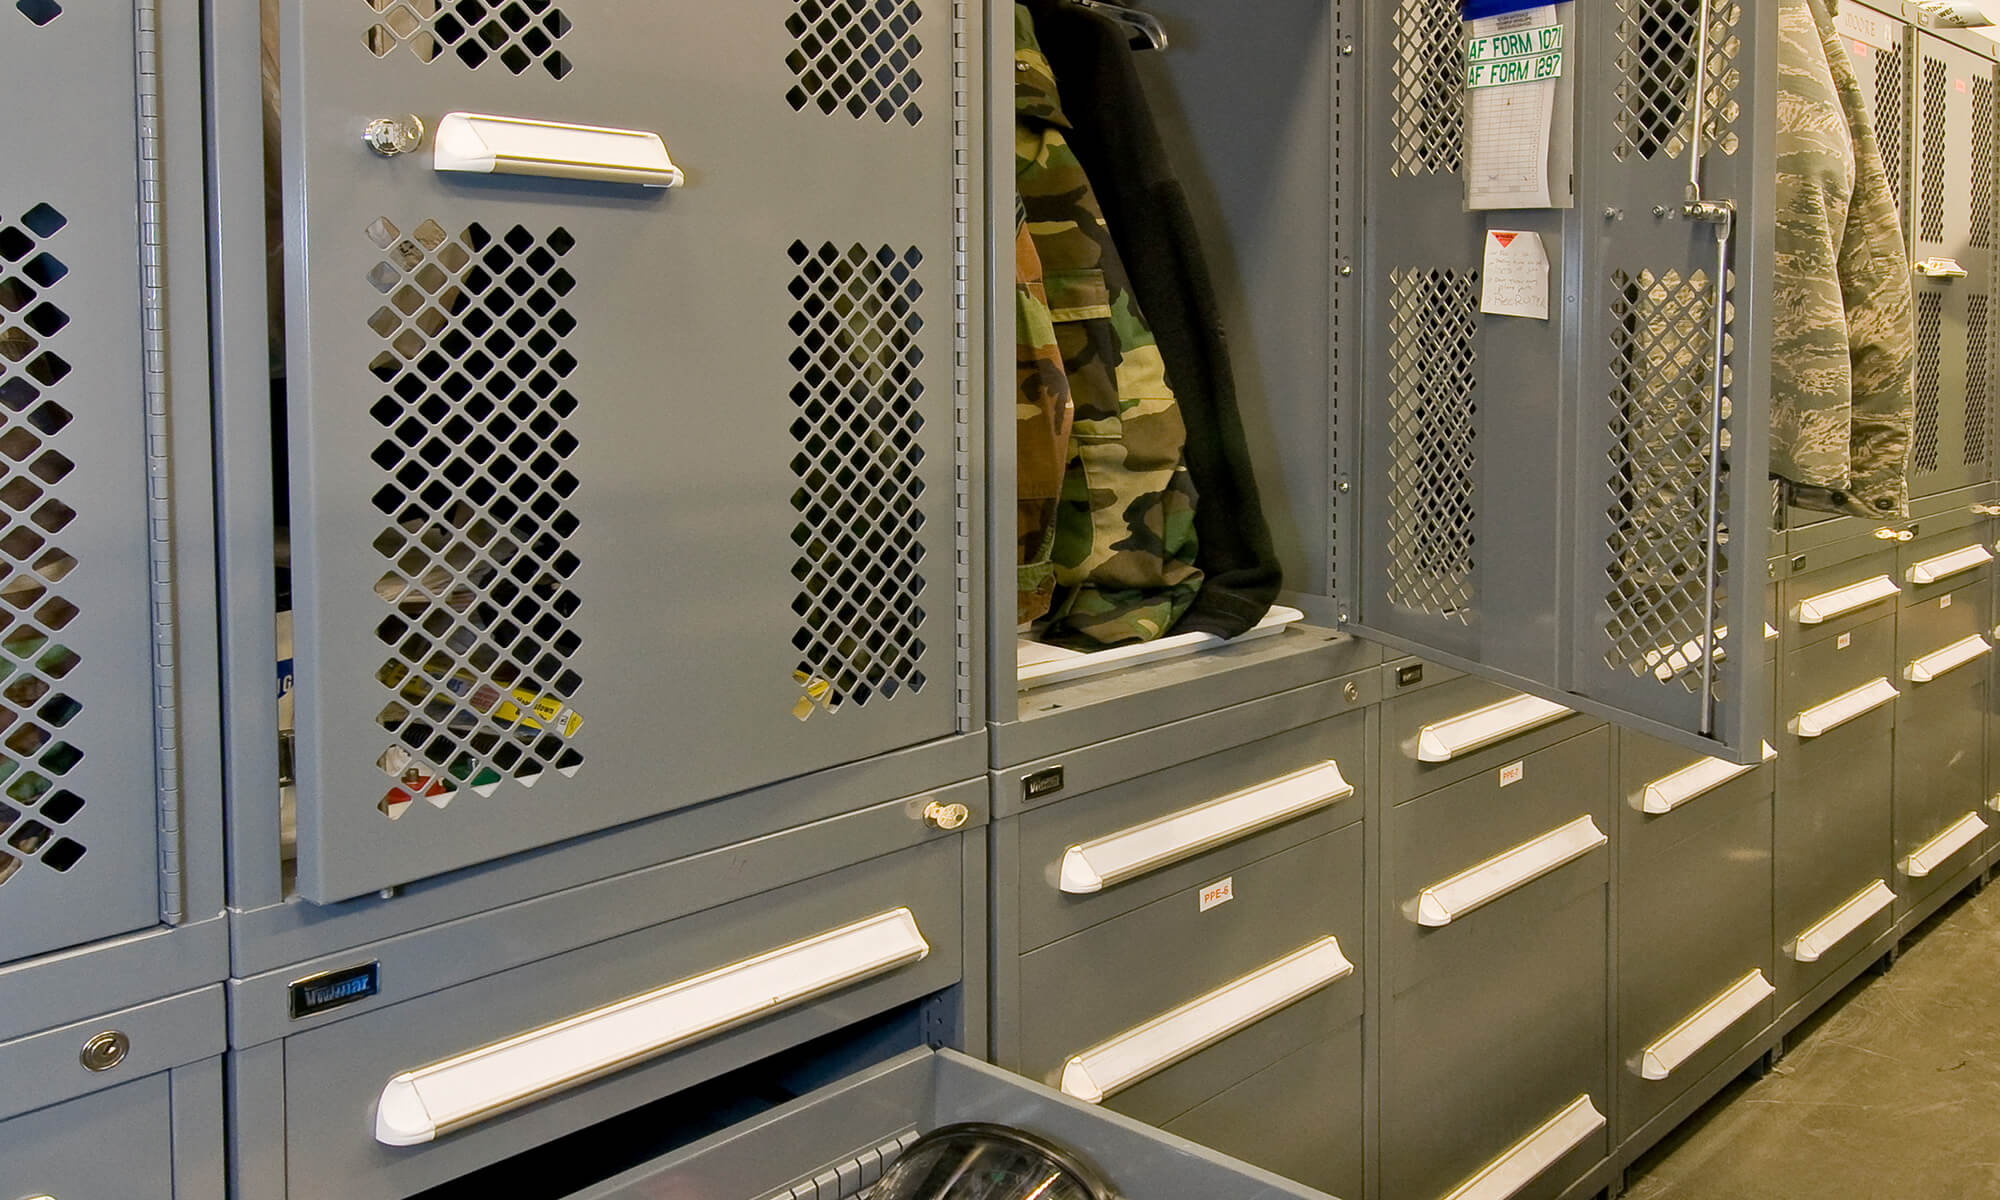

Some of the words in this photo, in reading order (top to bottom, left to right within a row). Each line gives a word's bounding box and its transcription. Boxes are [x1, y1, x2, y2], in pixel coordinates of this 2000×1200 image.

[1469, 40, 1487, 60] AF
[1493, 32, 1533, 57] FORM
[1538, 27, 1562, 51] 1071
[1468, 66, 1484, 86] AF
[1490, 60, 1529, 84] FORM
[1534, 54, 1561, 79] 1297
[1204, 884, 1229, 904] PPE-6
